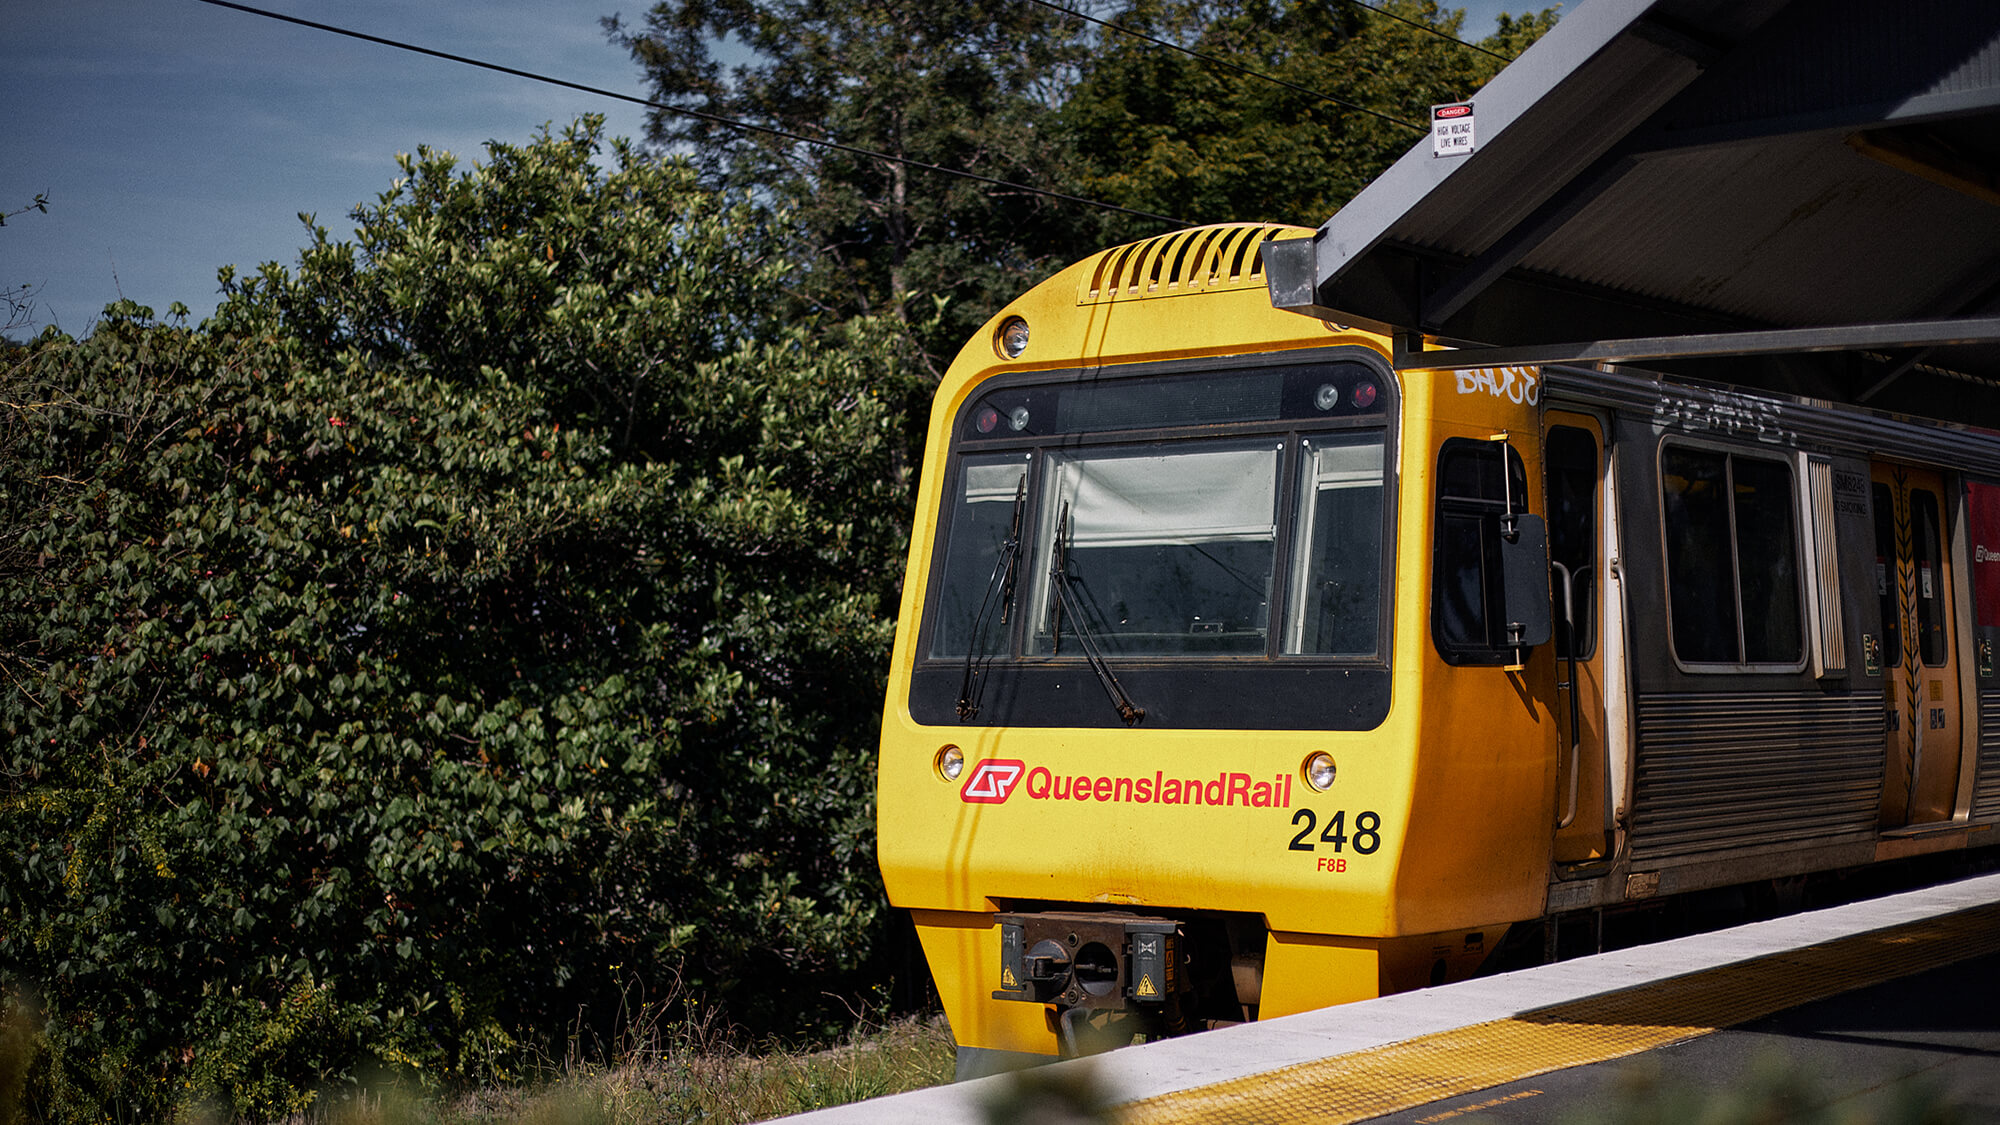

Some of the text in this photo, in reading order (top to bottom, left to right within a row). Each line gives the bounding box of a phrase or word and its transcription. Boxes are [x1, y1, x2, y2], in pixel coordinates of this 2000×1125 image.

[1437, 123, 1471, 136] HIGH VOLTAGE
[1440, 136, 1468, 148] LIVE WIRES
[1026, 766, 1292, 808] QueenslandRail
[1288, 808, 1381, 855] 248
[1317, 857, 1347, 873] F8B
